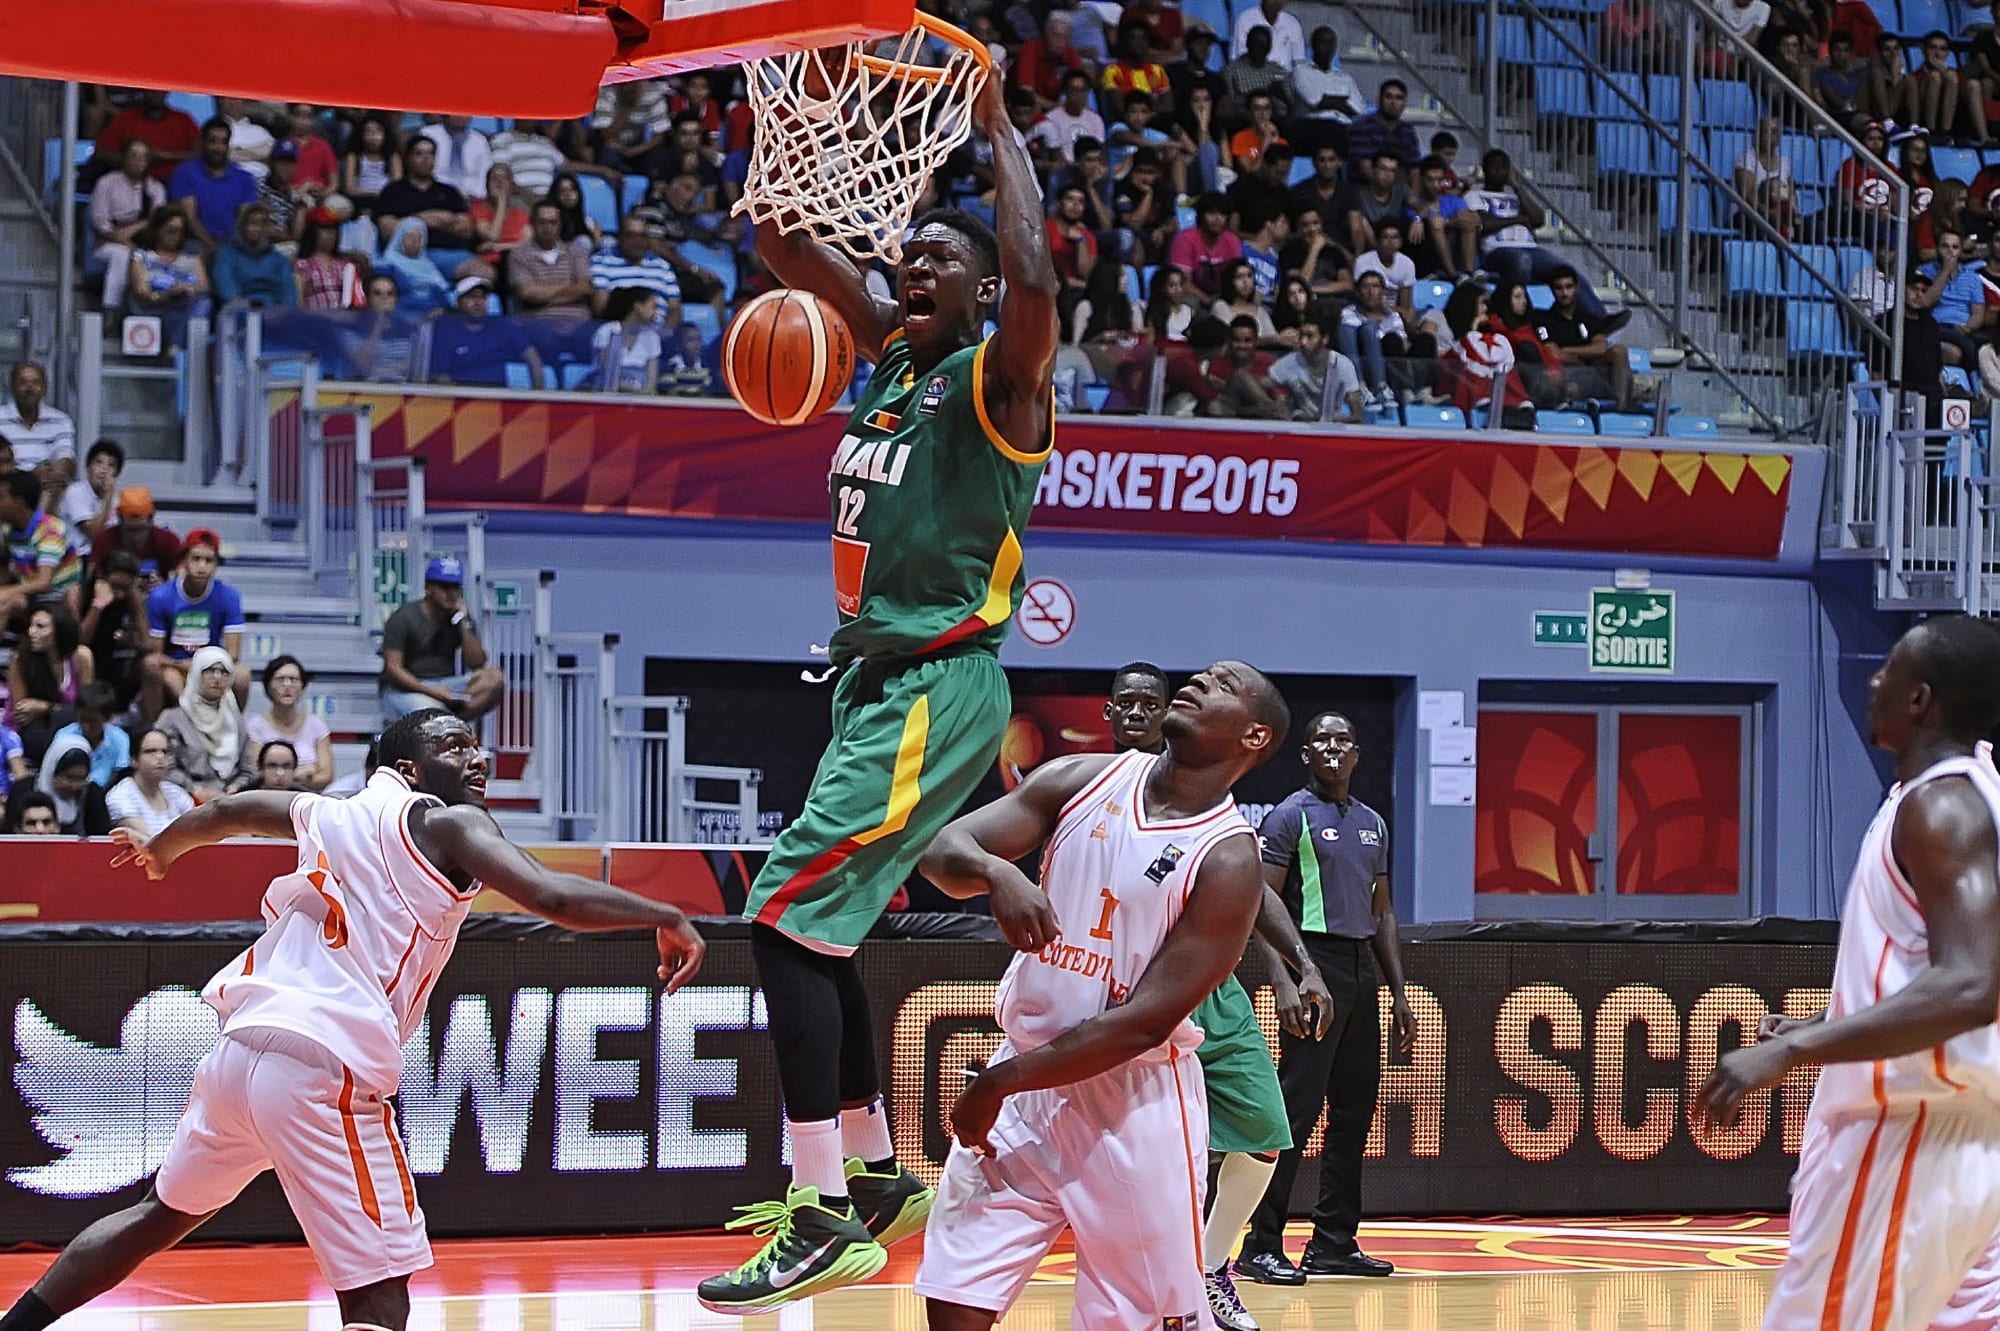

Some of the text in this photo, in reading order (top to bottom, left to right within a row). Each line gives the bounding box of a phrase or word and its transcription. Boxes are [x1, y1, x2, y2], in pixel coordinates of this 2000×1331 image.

[1033, 449, 1300, 517] ASKET2015
[837, 485, 866, 536] 12
[1597, 598, 1668, 636] خروج
[1595, 636, 1668, 665] SORTIE
[1089, 887, 1120, 940] 1
[399, 985, 792, 1176] WEE
